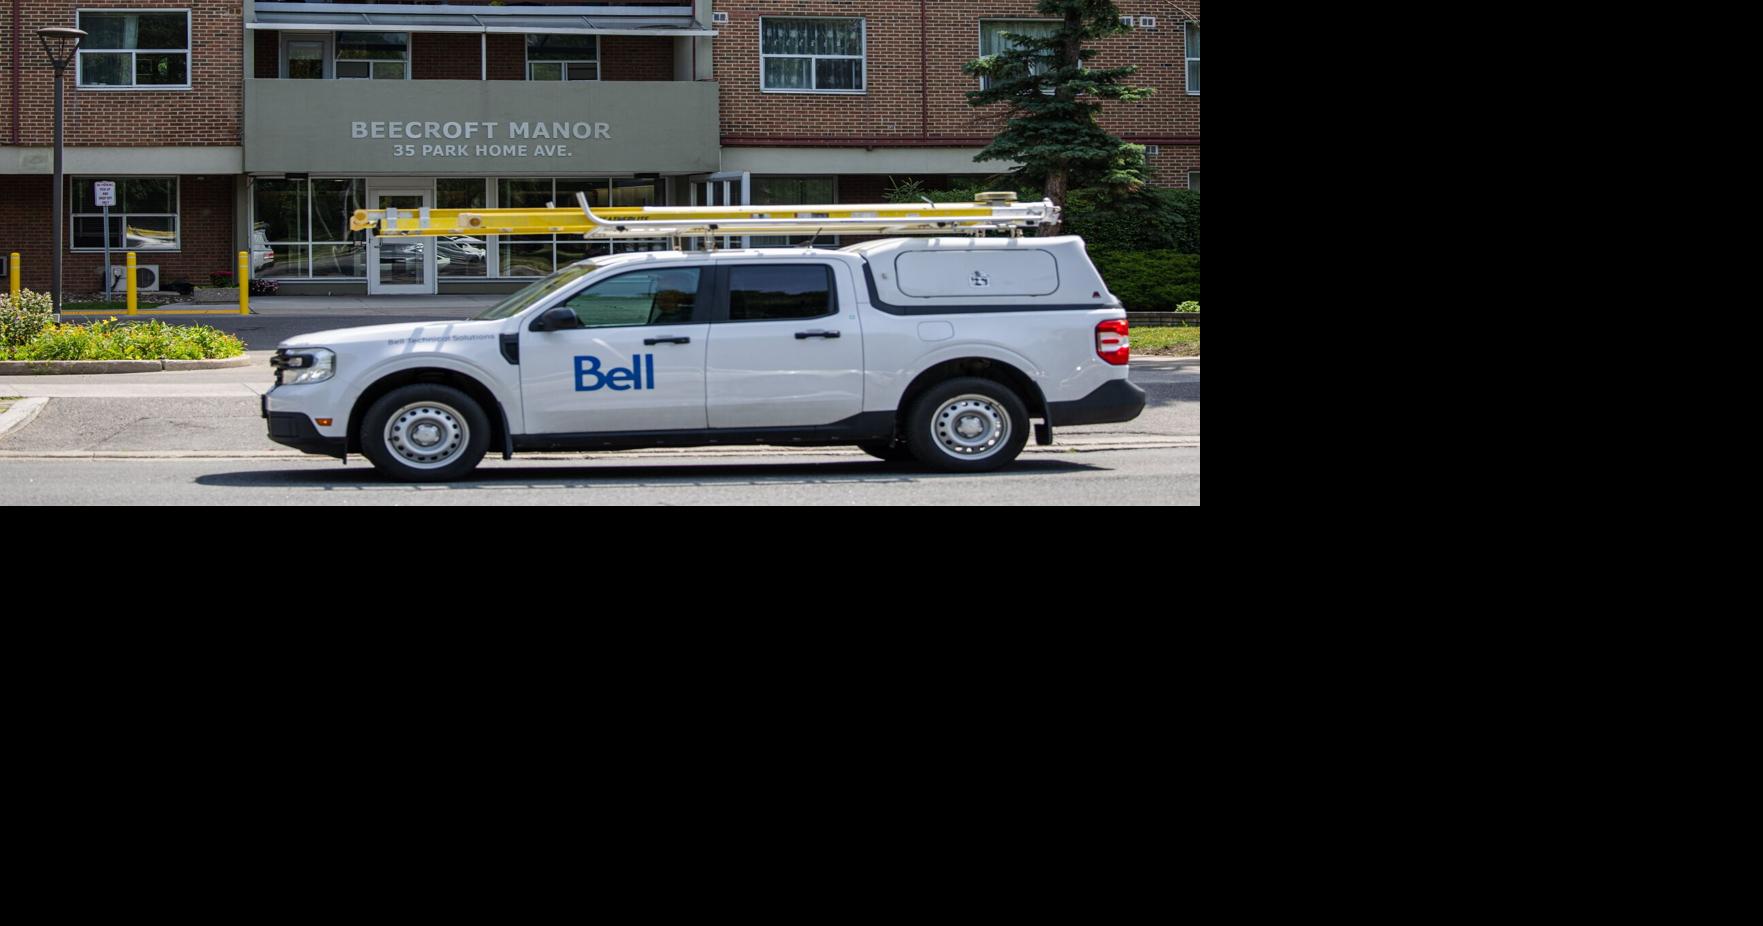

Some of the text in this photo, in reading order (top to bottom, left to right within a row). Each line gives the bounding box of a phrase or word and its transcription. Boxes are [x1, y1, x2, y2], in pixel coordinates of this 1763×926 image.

[351, 121, 612, 139] BEECROFT MANOR
[393, 144, 573, 157] 35 PARK HOME AVE.
[452, 333, 495, 342] Solutions
[574, 353, 655, 392] Bell
